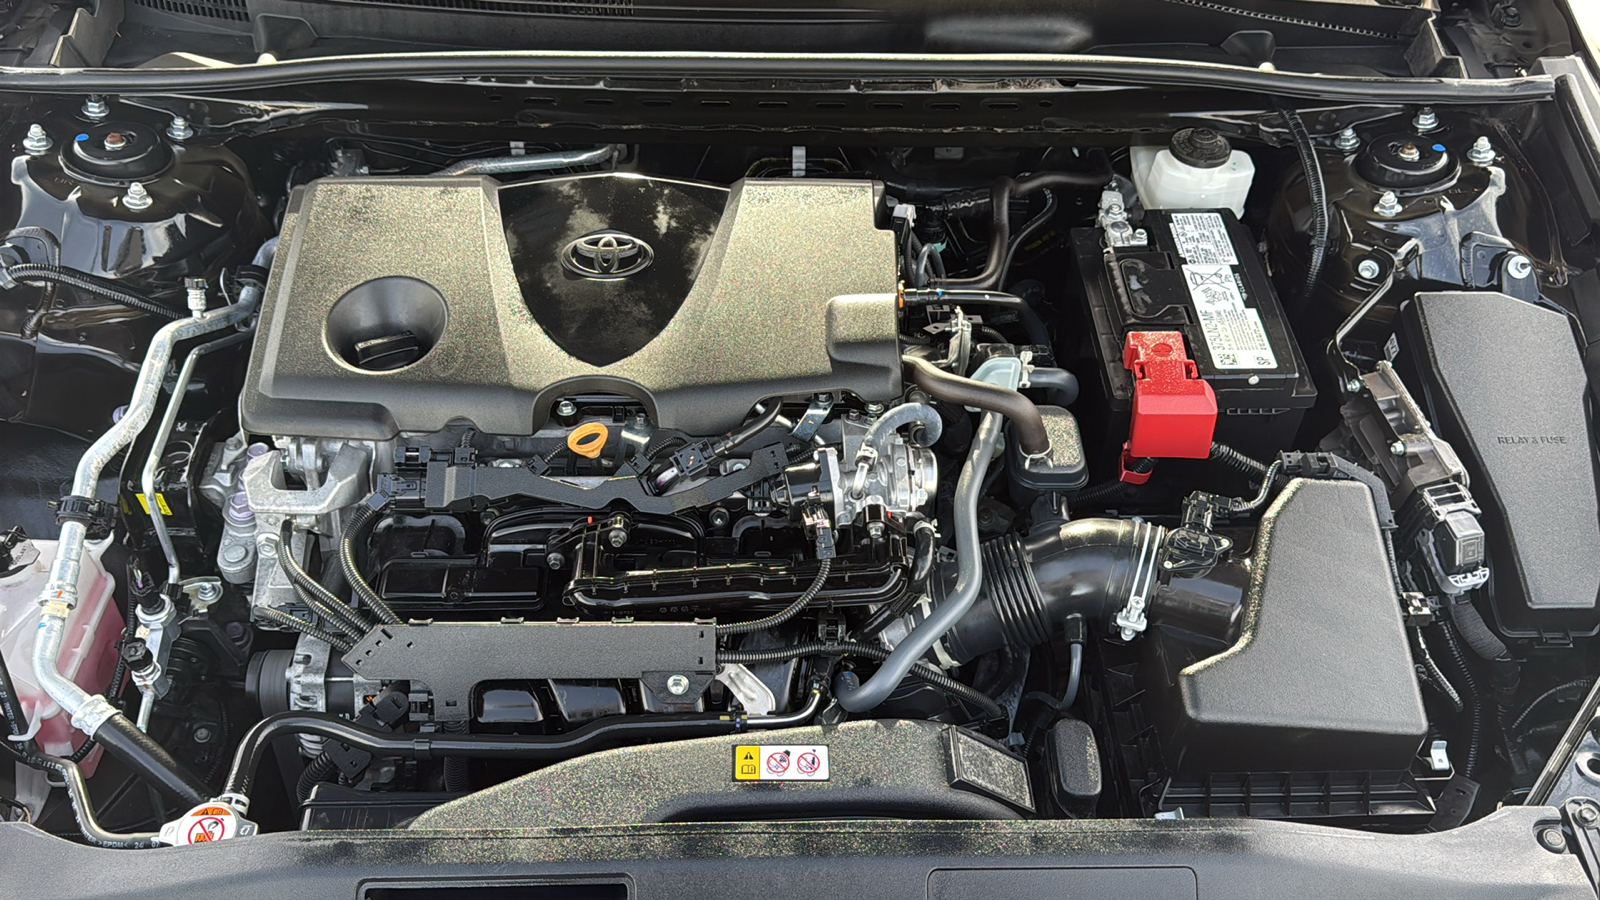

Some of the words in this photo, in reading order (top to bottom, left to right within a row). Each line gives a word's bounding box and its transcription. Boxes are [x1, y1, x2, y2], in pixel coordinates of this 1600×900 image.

[1234, 273, 1246, 293] CLARIOS
[1200, 310, 1225, 351] 375LN2-MF
[1256, 356, 1271, 365] SP
[1497, 436, 1529, 444] RELAY
[1531, 436, 1539, 444] &
[1541, 436, 1567, 444] FUSE
